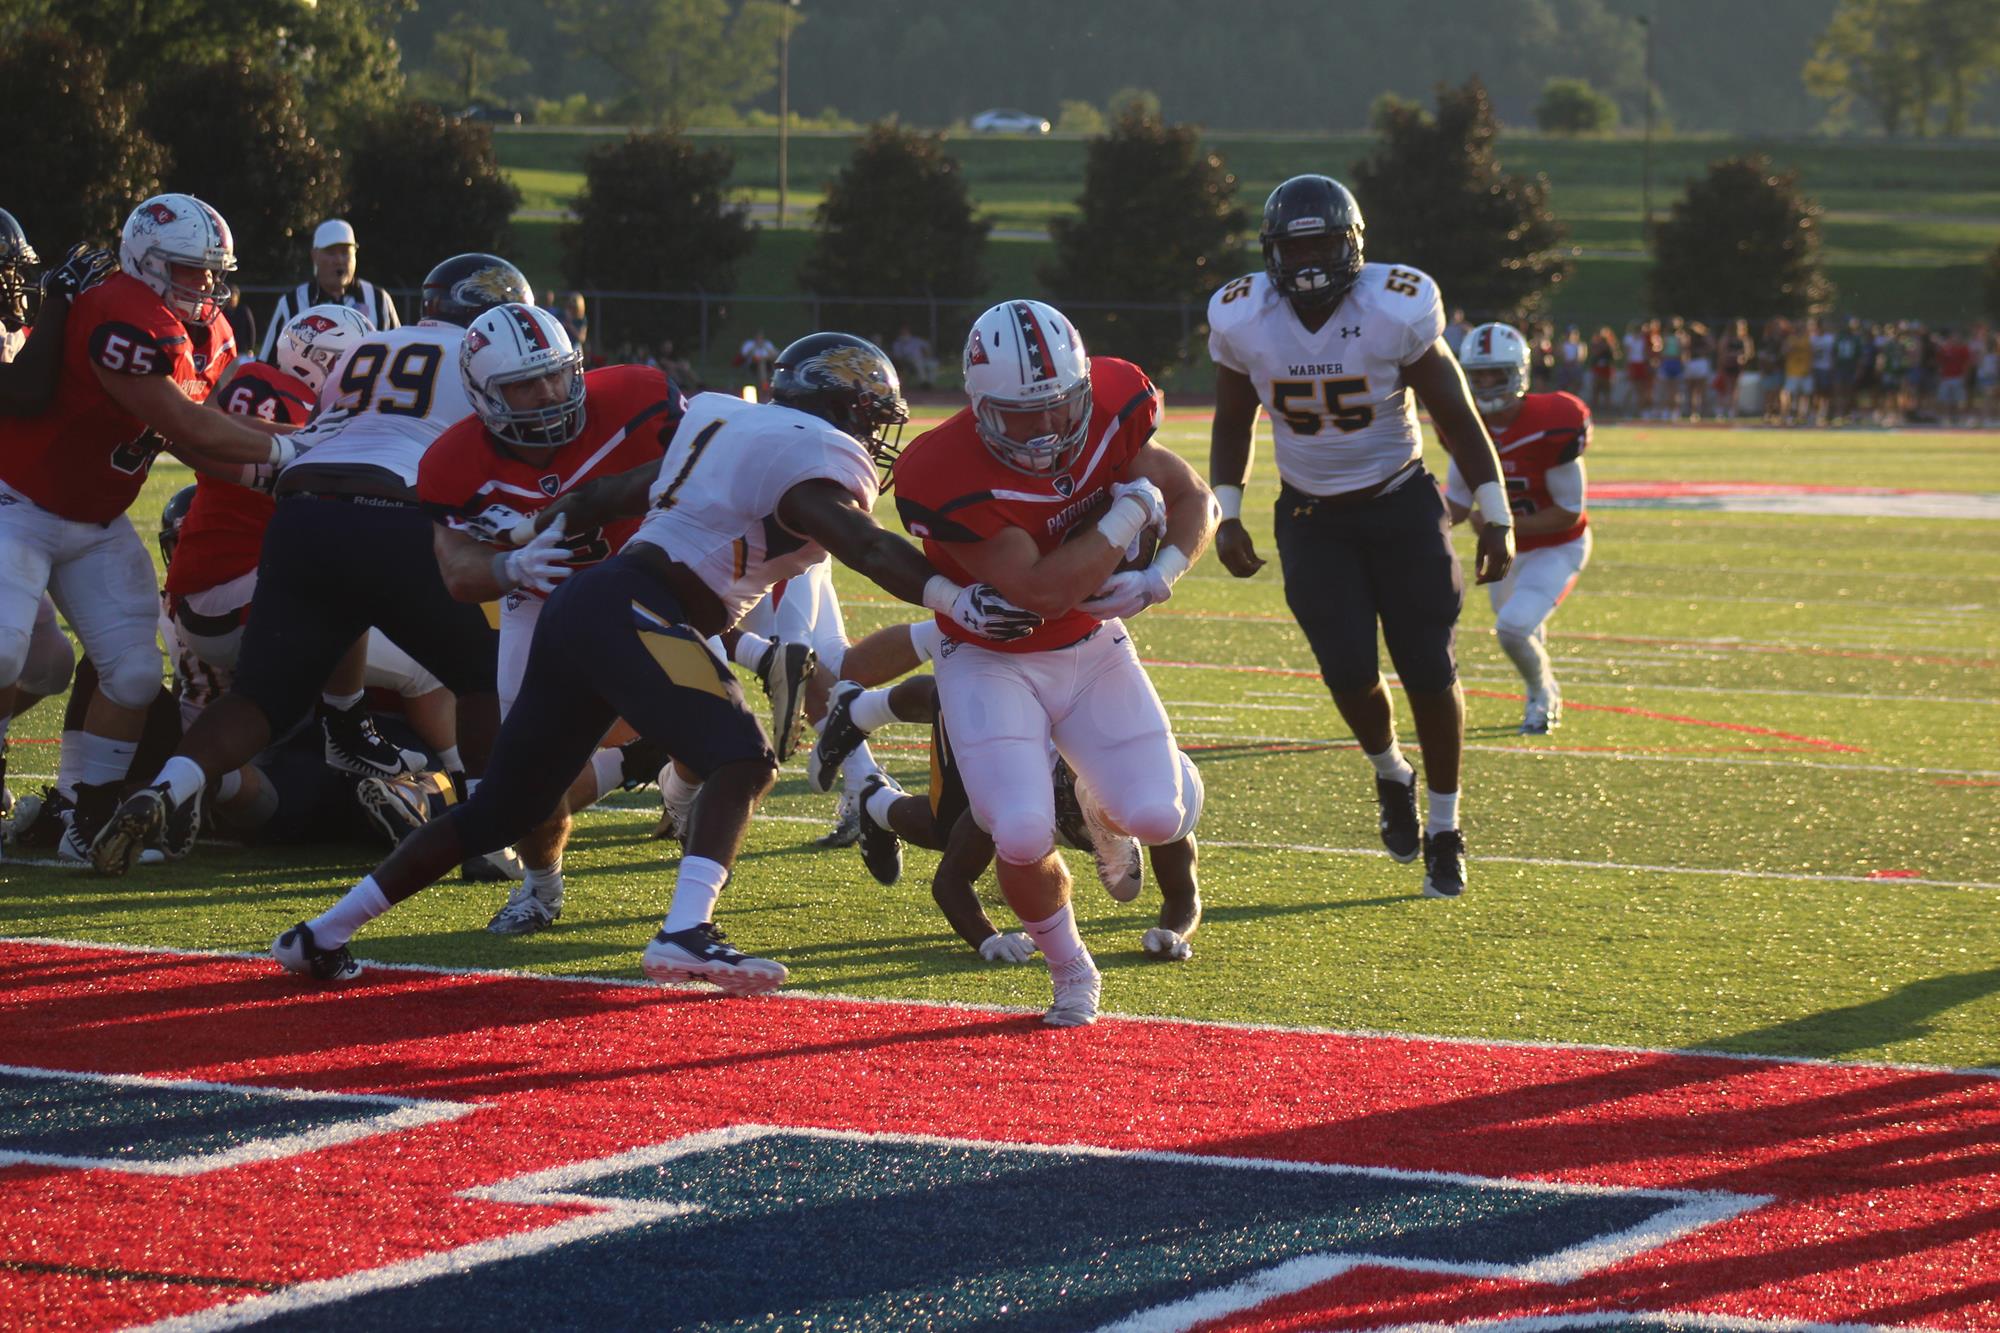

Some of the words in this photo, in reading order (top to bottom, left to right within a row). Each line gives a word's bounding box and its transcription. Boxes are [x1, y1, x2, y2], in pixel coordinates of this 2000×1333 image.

[1221, 276, 1254, 304] 55
[1384, 268, 1421, 298] 55
[102, 334, 156, 375] 55
[1288, 363, 1343, 376] WARNER
[340, 343, 443, 419] 99
[228, 387, 276, 421] 64
[1270, 375, 1376, 436] 55
[653, 418, 727, 511] 1
[1047, 486, 1104, 536] PATRIOTS
